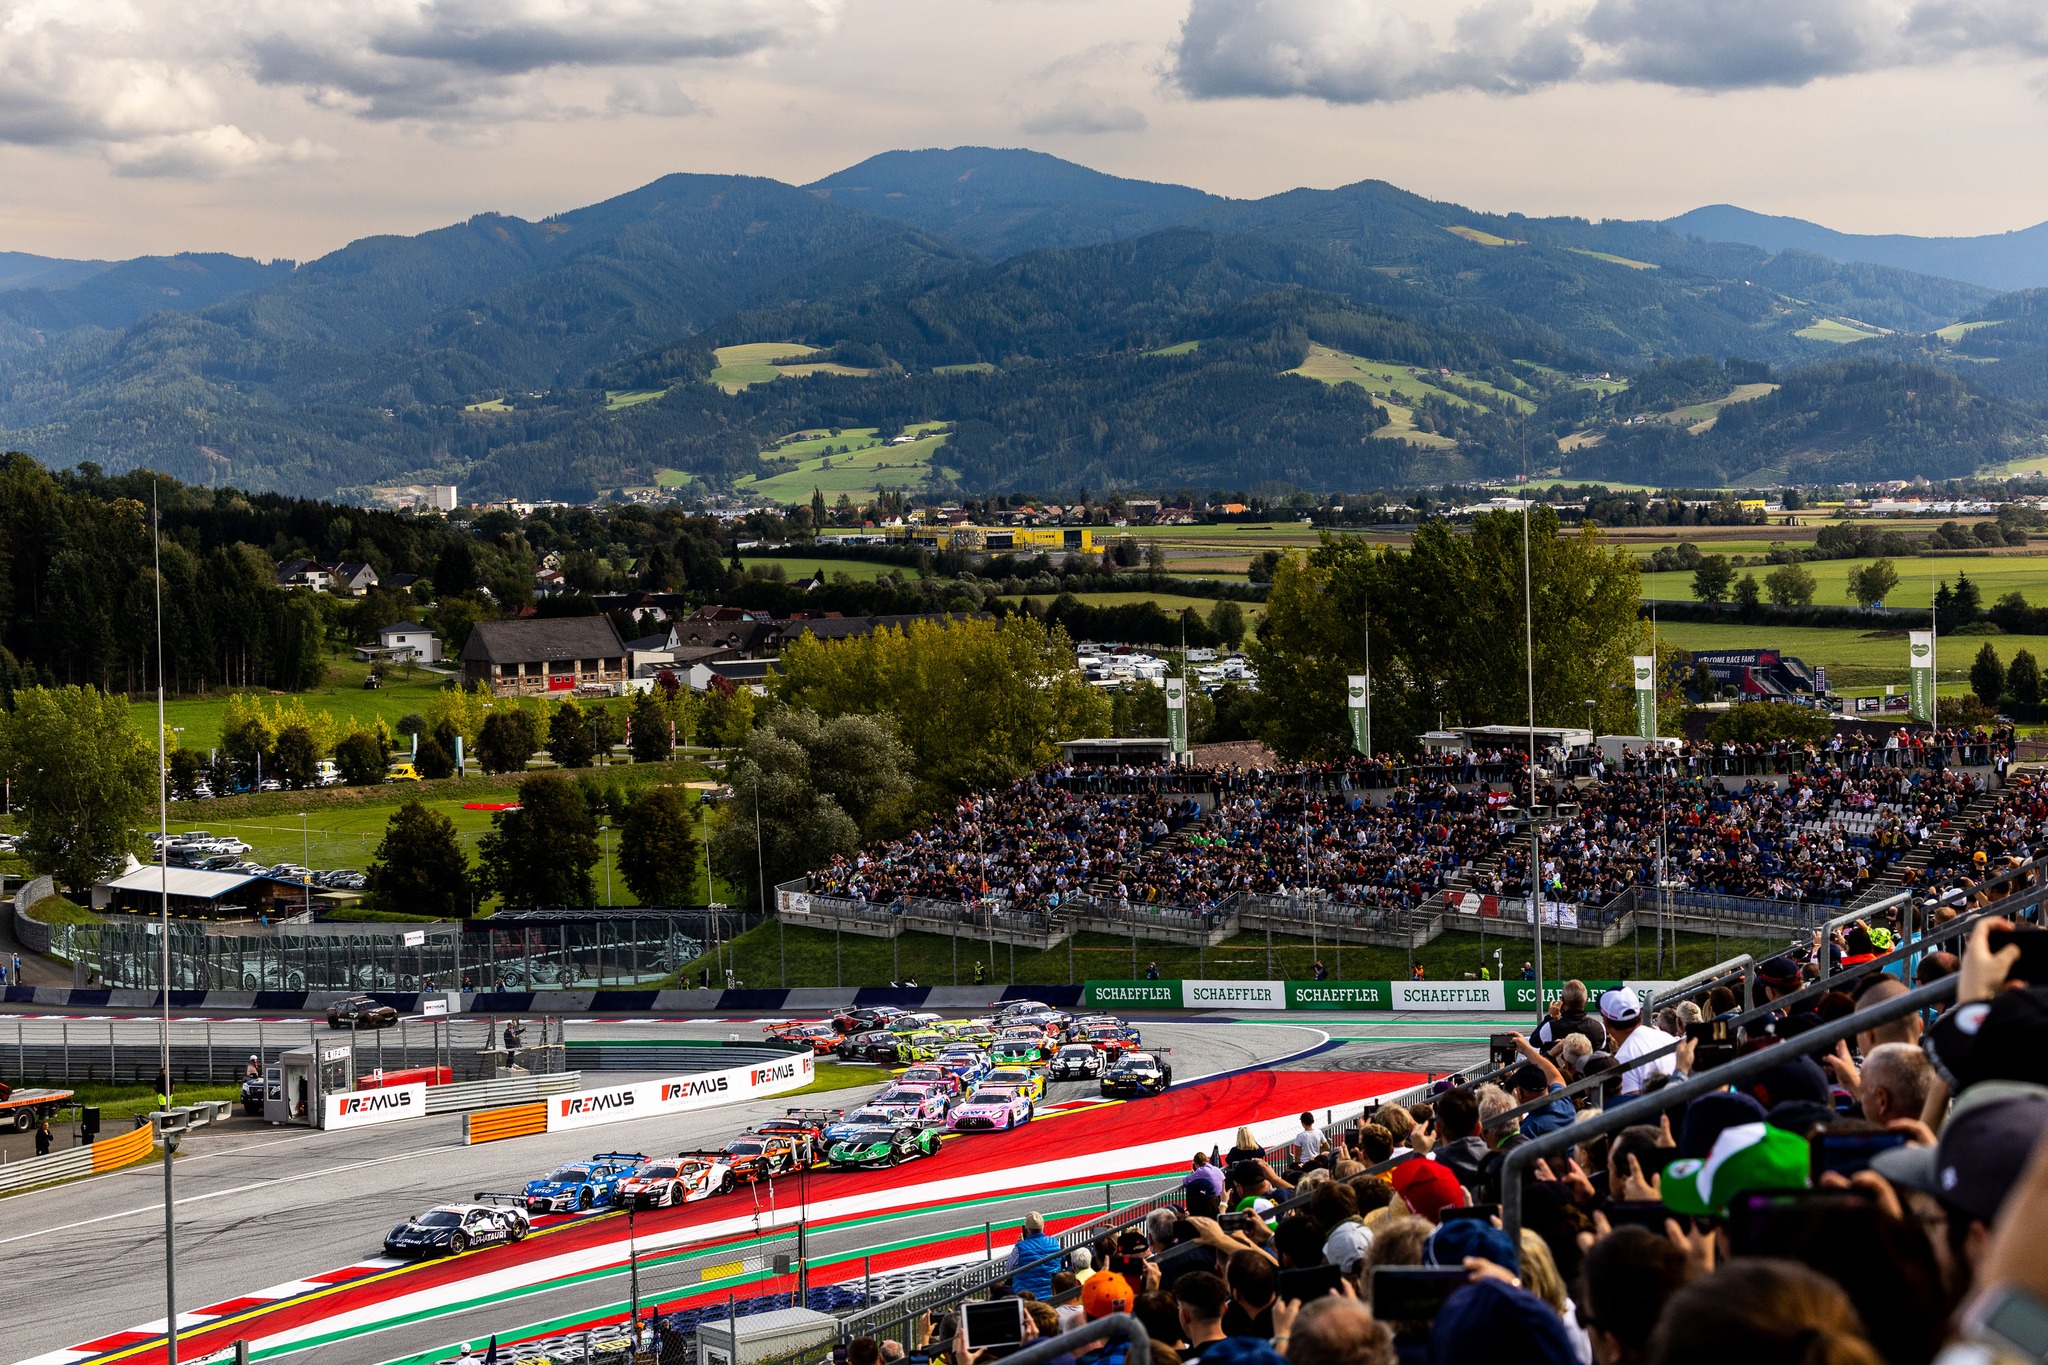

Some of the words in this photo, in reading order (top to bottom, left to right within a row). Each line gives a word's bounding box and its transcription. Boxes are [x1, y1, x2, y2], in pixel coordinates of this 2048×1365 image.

[1741, 655, 1755, 663] FANS
[1096, 987, 1171, 1000] SCHAEFFLER
[1193, 988, 1272, 1001] SCHAEFFLER
[1296, 988, 1379, 1002] SCHAEFFLER
[1404, 989, 1490, 1002] SCHAEFFLER
[757, 1063, 795, 1085] REMUS
[669, 1076, 728, 1100] REMUS
[347, 1091, 411, 1114] REMUS
[569, 1091, 635, 1115] REMUS
[469, 1231, 507, 1247] ALPHATAURI
